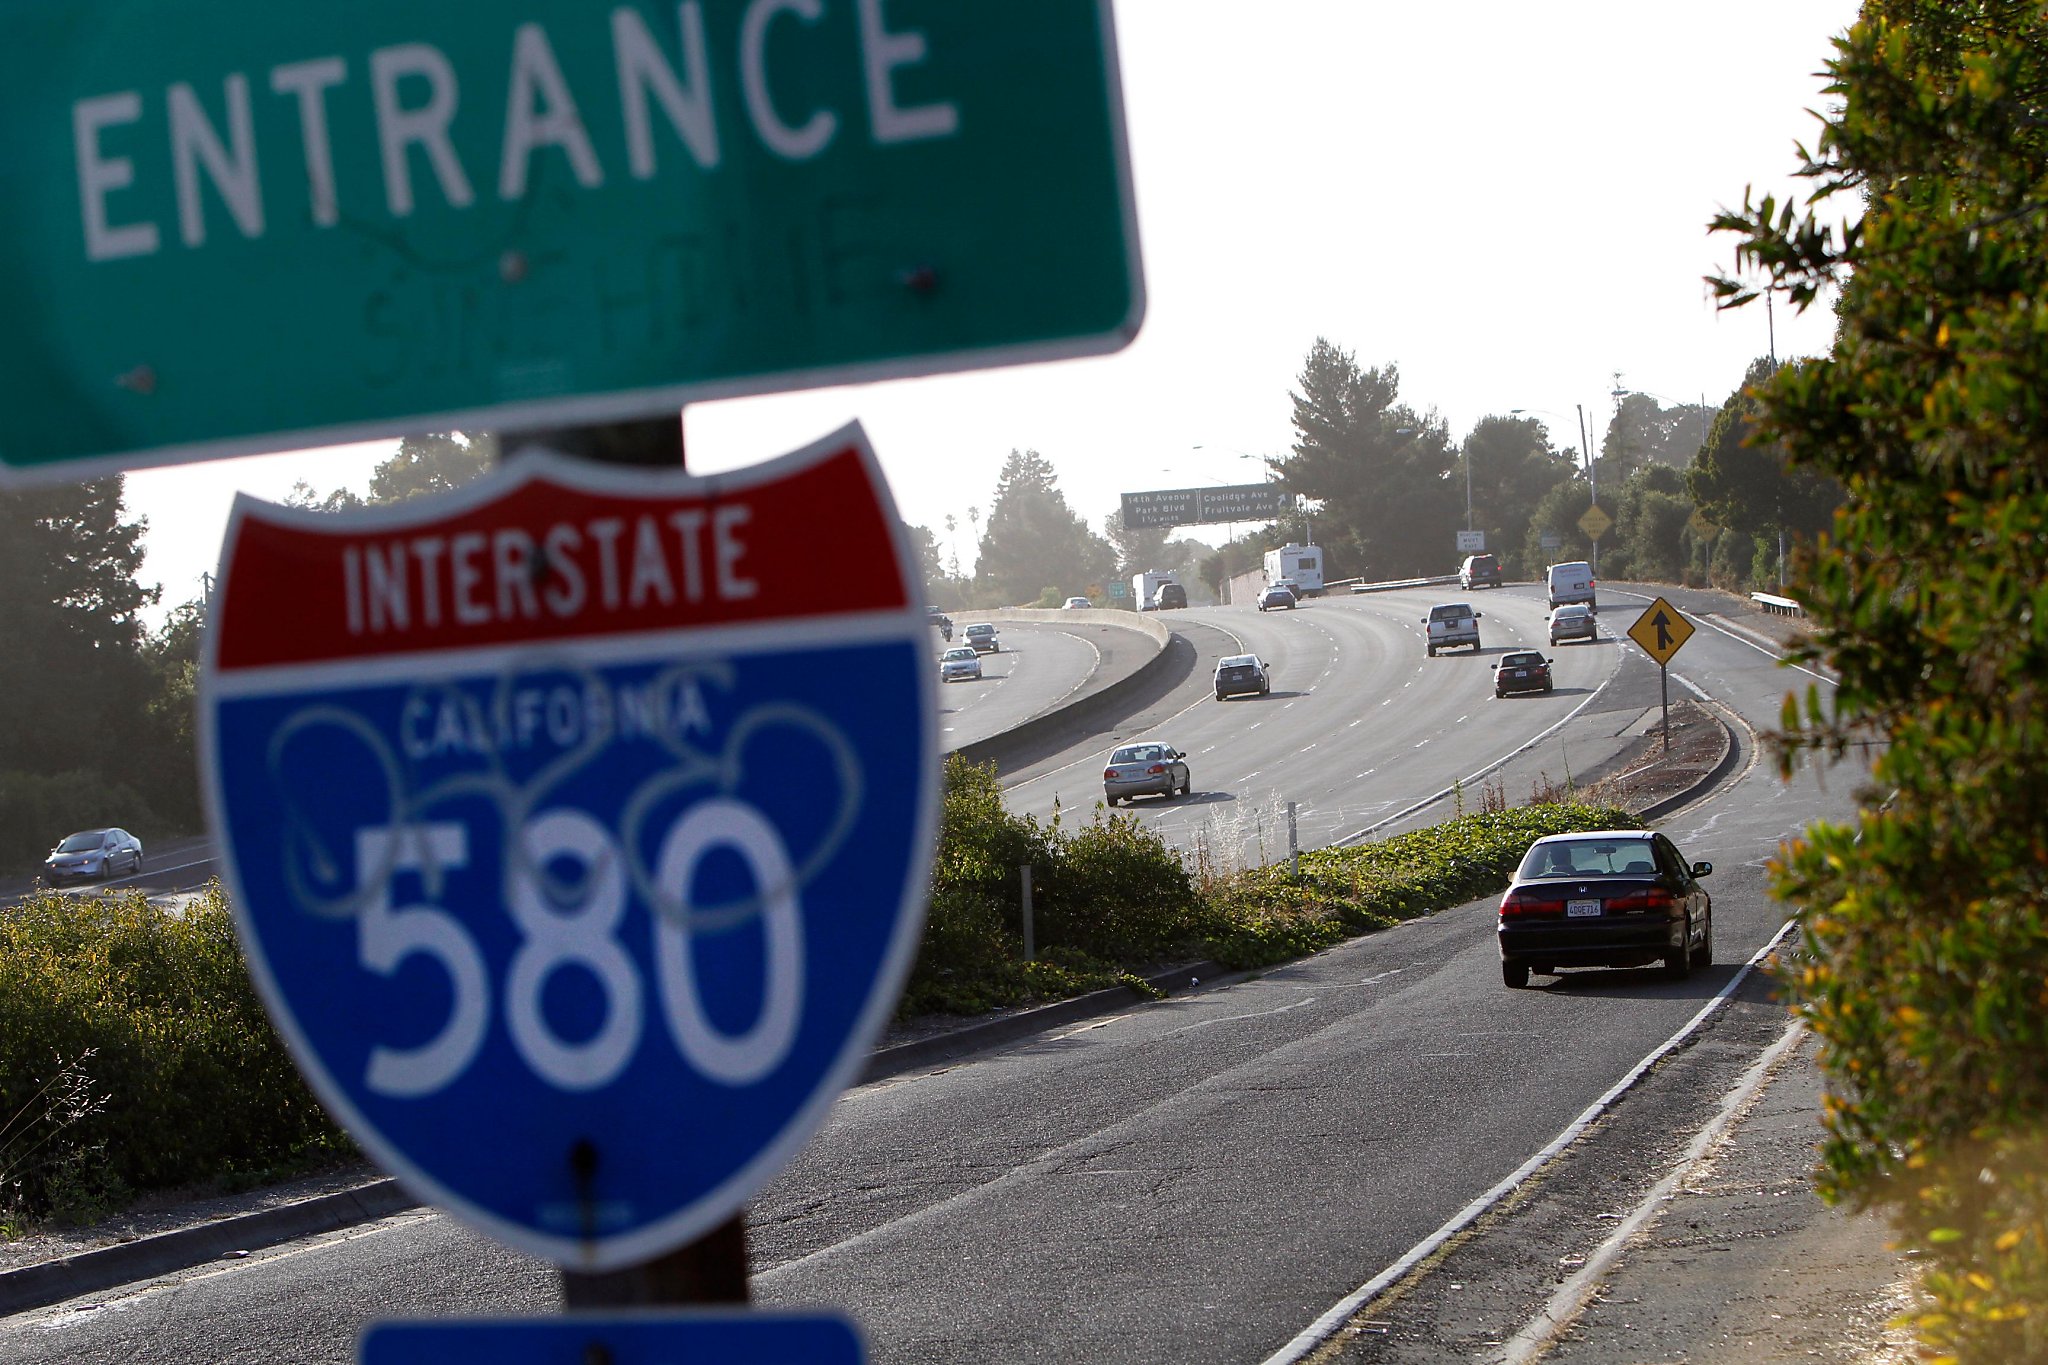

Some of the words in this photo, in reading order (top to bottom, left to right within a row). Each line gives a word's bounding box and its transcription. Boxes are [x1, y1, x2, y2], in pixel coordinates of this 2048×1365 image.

[73, 0, 959, 262] ENTRANCE
[1128, 495, 1150, 504] 14th
[1155, 493, 1191, 502] Avenue
[1203, 492, 1246, 502] Coolidge
[1251, 491, 1268, 499] Ave
[1135, 505, 1158, 515] Park
[1162, 503, 1185, 513] Blvd
[1204, 504, 1251, 514] Fruitvale
[1255, 502, 1273, 511] Ave
[342, 504, 759, 634] INTERSTATE
[355, 796, 806, 1099] 580
